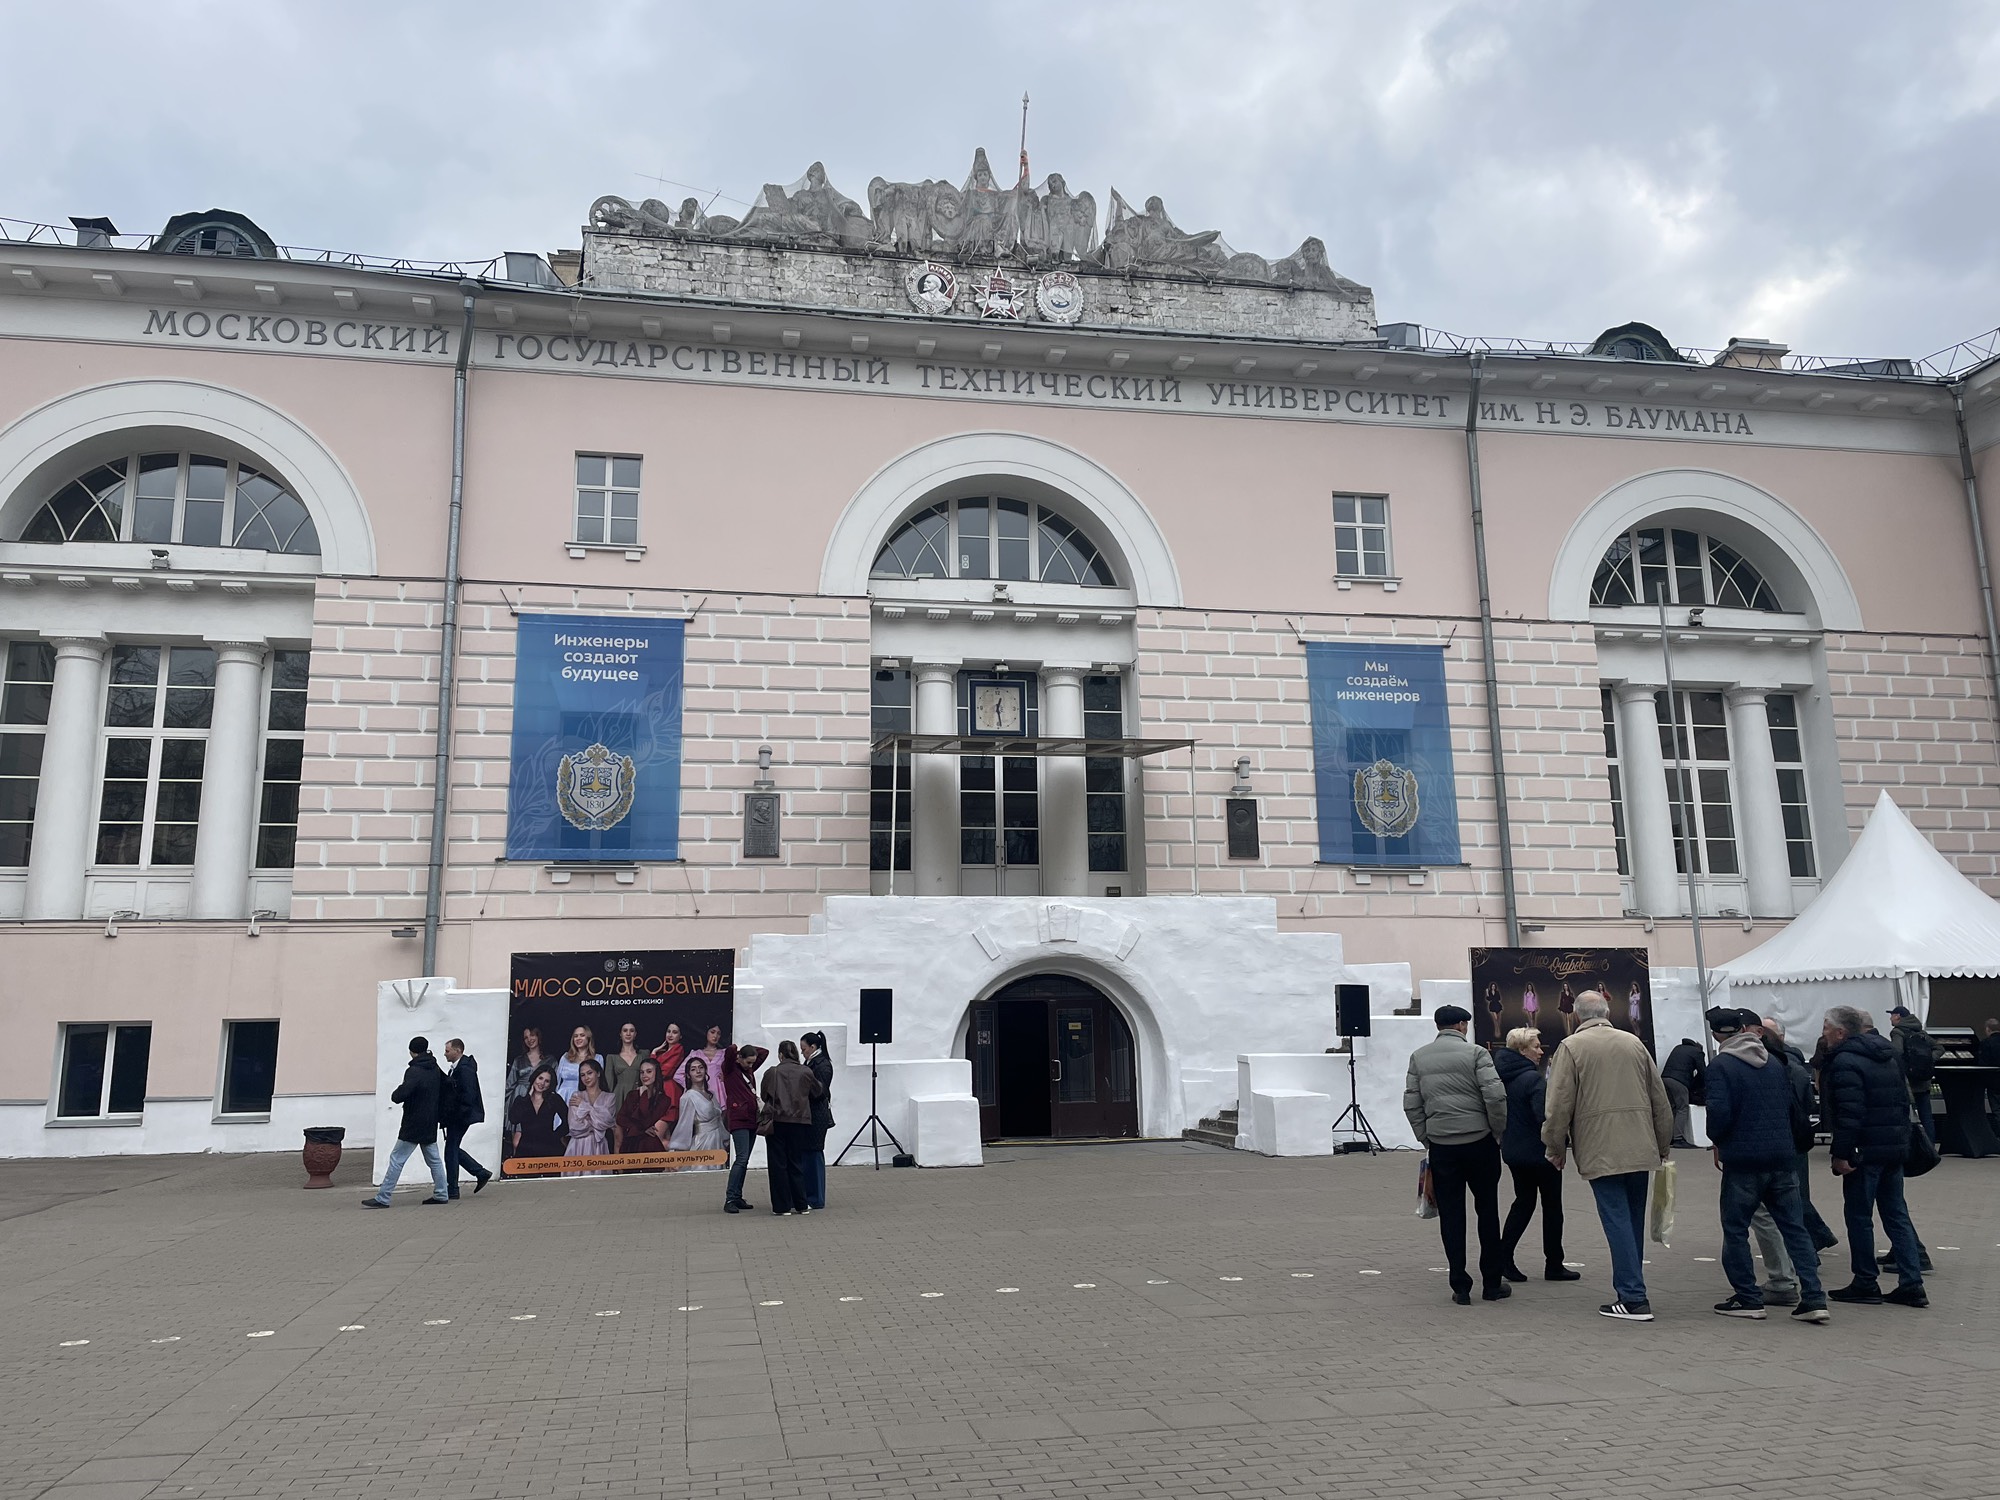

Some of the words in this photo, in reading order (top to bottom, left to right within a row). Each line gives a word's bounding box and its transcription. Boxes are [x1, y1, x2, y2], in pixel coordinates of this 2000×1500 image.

[142, 308, 450, 356] МОСКОВСКИЙ
[494, 333, 892, 385] ГОСУДАРСТВЕННЫЙ
[916, 364, 1183, 404] ТЕХНИЧЕСКИЙ
[1206, 382, 1453, 419] УНИВЕРСИТЕТ
[1535, 401, 1562, 425] Н.
[1569, 404, 1592, 428] Э.
[1606, 406, 1754, 435] БАУМАНА
[555, 634, 649, 650] Инженеры
[563, 652, 638, 665] создают
[1364, 661, 1388, 671] Мы
[561, 666, 639, 681] будущее
[1346, 675, 1409, 687] создаём
[1337, 690, 1420, 703] инженеров
[586, 800, 605, 809] 1830
[514, 977, 581, 998] МИСС
[580, 999, 609, 1007] ВЫБЕРИ
[516, 1162, 526, 1170] 23
[528, 1161, 561, 1171] апреля,
[562, 1160, 585, 1169] 17:30,
[586, 1158, 625, 1167] Большой
[627, 1157, 642, 1165] зал
[643, 1156, 675, 1166] Дворца
[676, 1153, 715, 1164] культуры
